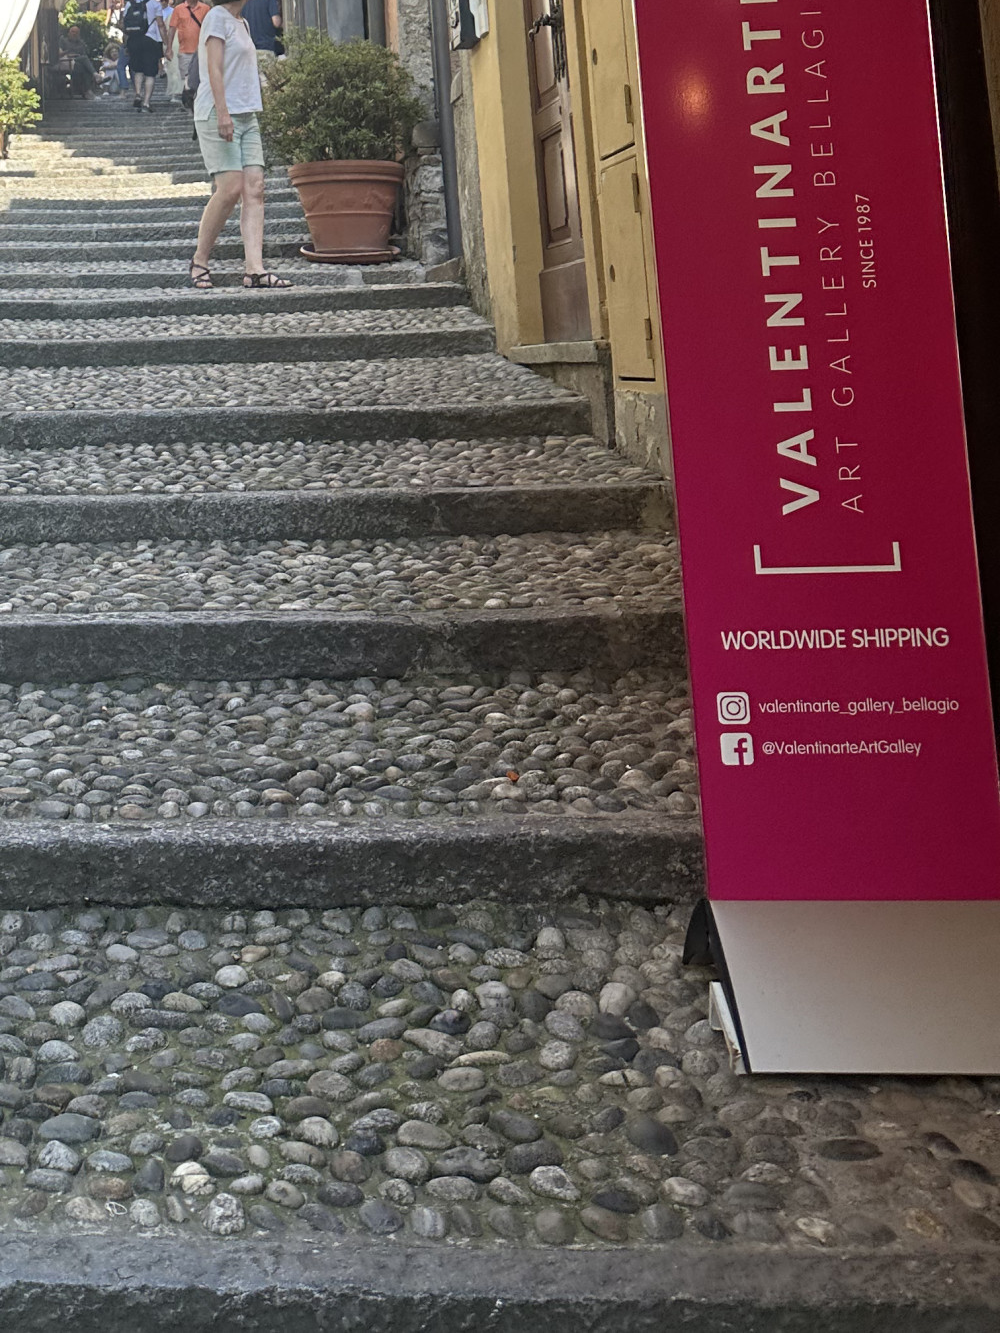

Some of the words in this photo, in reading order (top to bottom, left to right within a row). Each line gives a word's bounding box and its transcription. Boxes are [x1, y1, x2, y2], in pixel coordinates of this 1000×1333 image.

[855, 194, 872, 233] 1987
[859, 239, 877, 288] SINCE
[816, 217, 856, 407] GALLERY
[835, 436, 864, 513] ART
[720, 629, 847, 650] WORLDWIDE
[851, 627, 950, 648] SHIPPING
[758, 697, 960, 716] valentinarte_gallery_bellagio
[762, 739, 922, 757] @ValentinarteArtGalley
